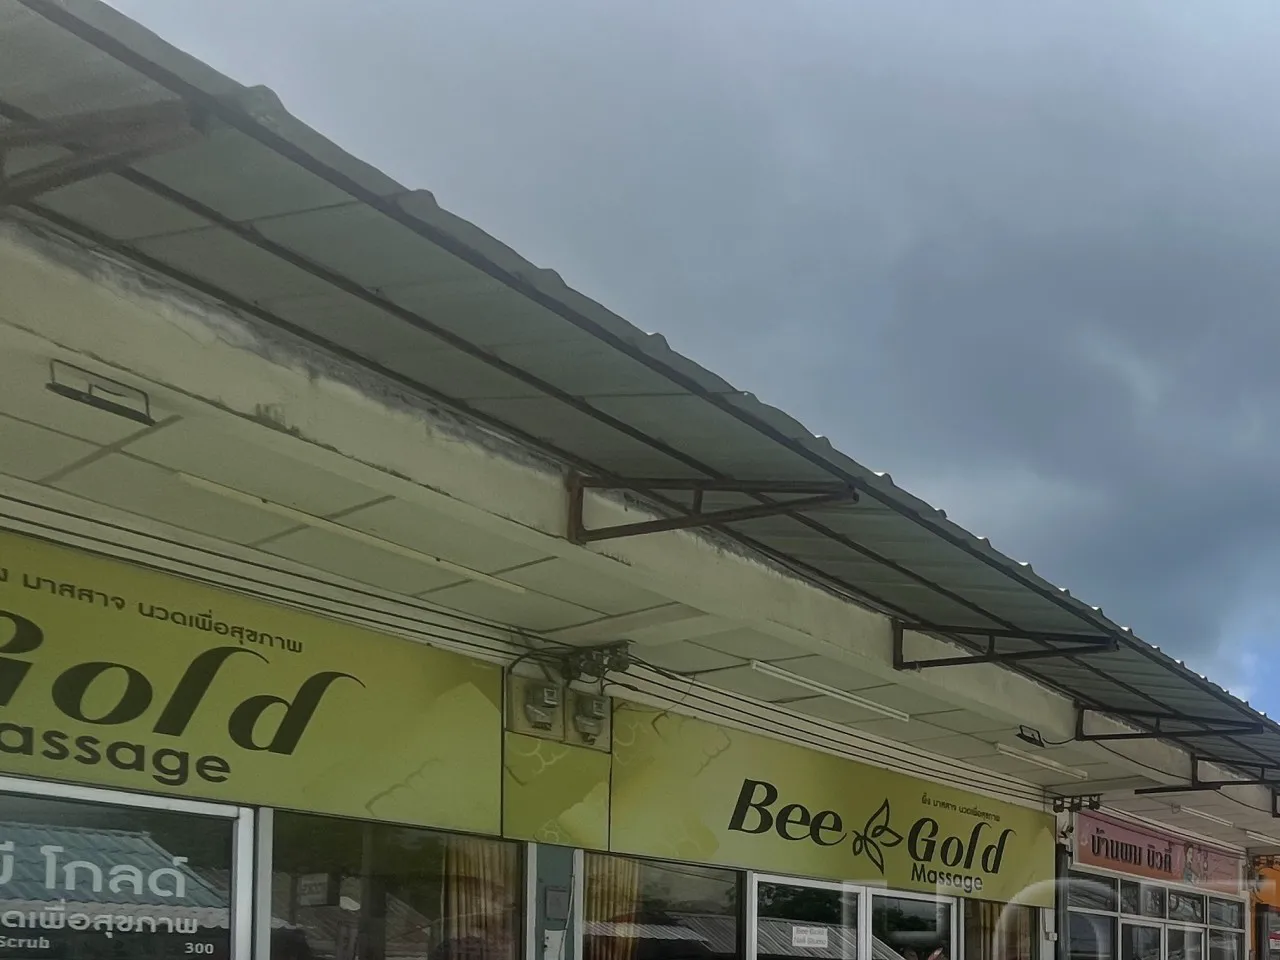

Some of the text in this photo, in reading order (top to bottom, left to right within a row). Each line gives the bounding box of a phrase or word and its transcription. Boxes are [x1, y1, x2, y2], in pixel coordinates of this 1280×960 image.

[728, 779, 847, 846] Bee
[40, 844, 188, 898] โกลด์
[907, 817, 1018, 874] Gold
[911, 862, 983, 893] Massage
[184, 942, 214, 955] 300
